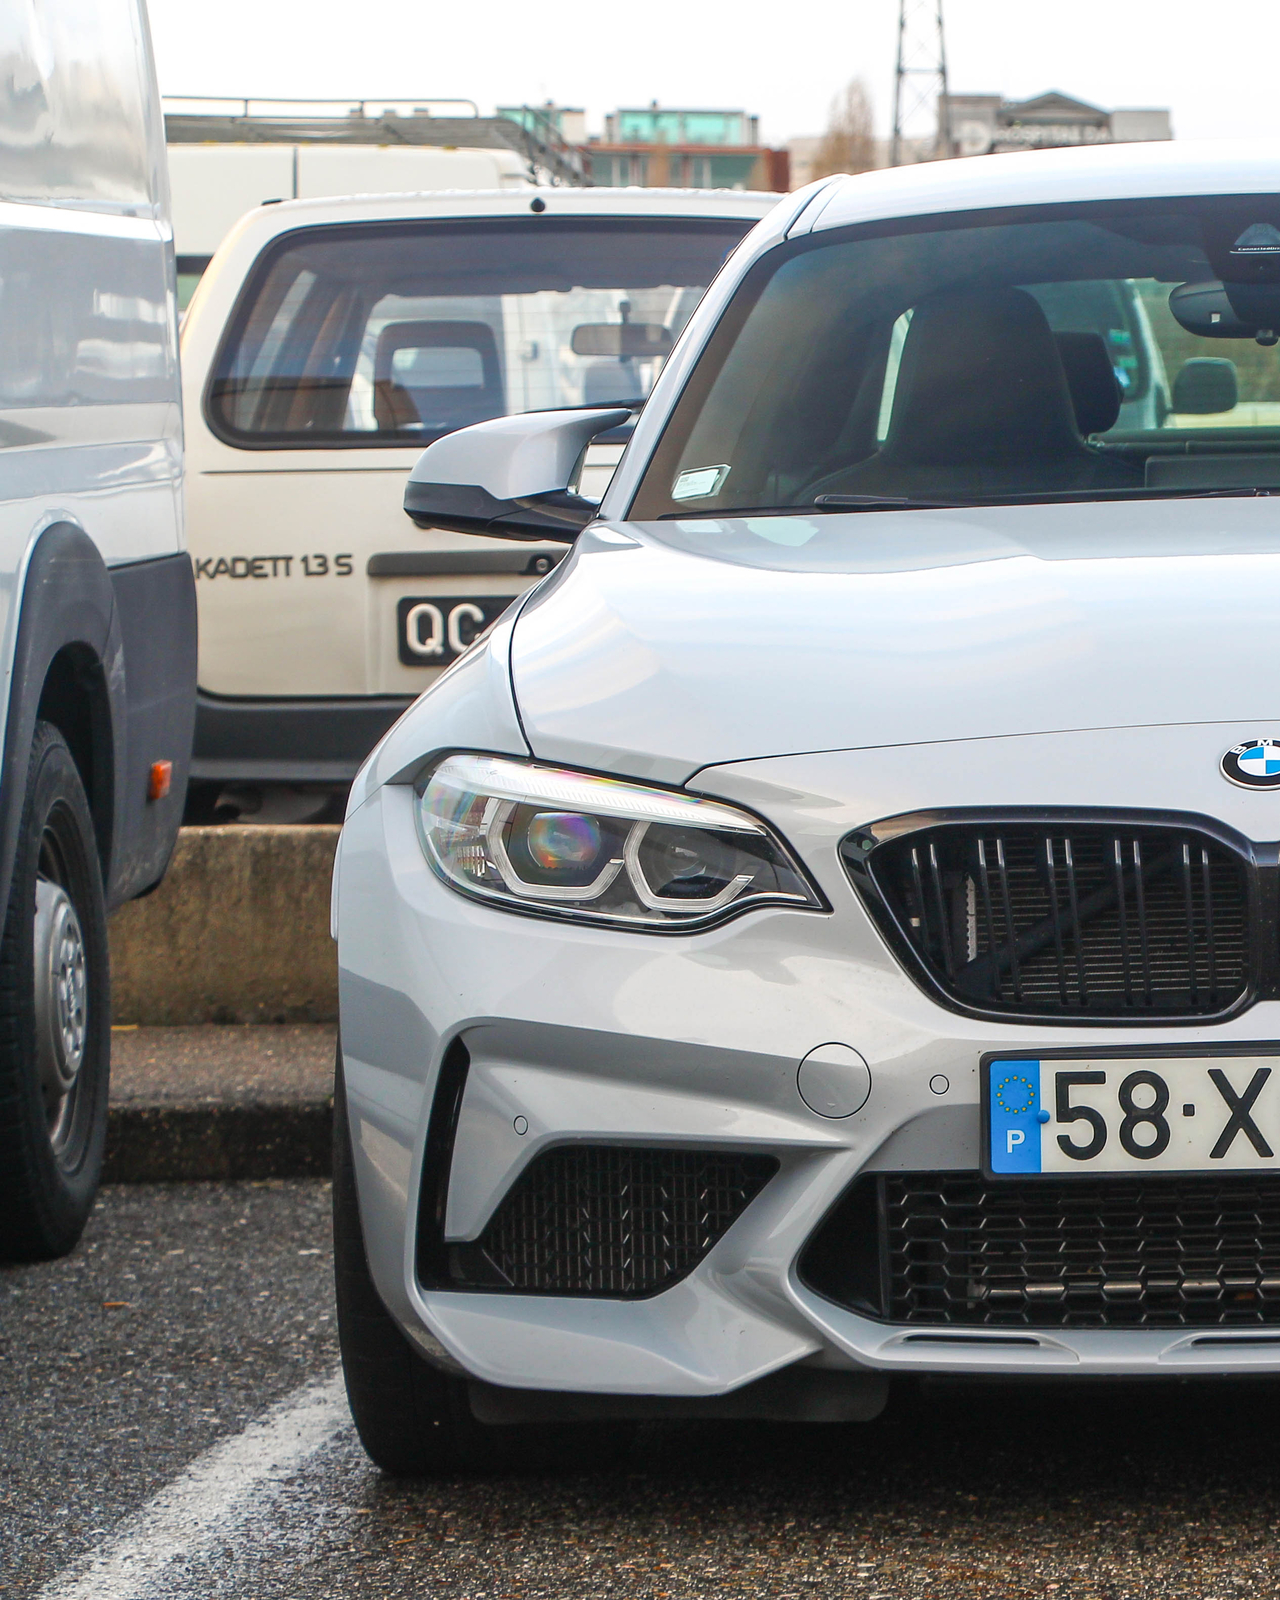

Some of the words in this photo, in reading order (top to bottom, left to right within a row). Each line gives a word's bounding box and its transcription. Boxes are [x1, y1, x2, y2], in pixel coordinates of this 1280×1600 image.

[196, 556, 294, 579] KADETT
[336, 554, 353, 575] S
[1006, 1129, 1026, 1153] P
